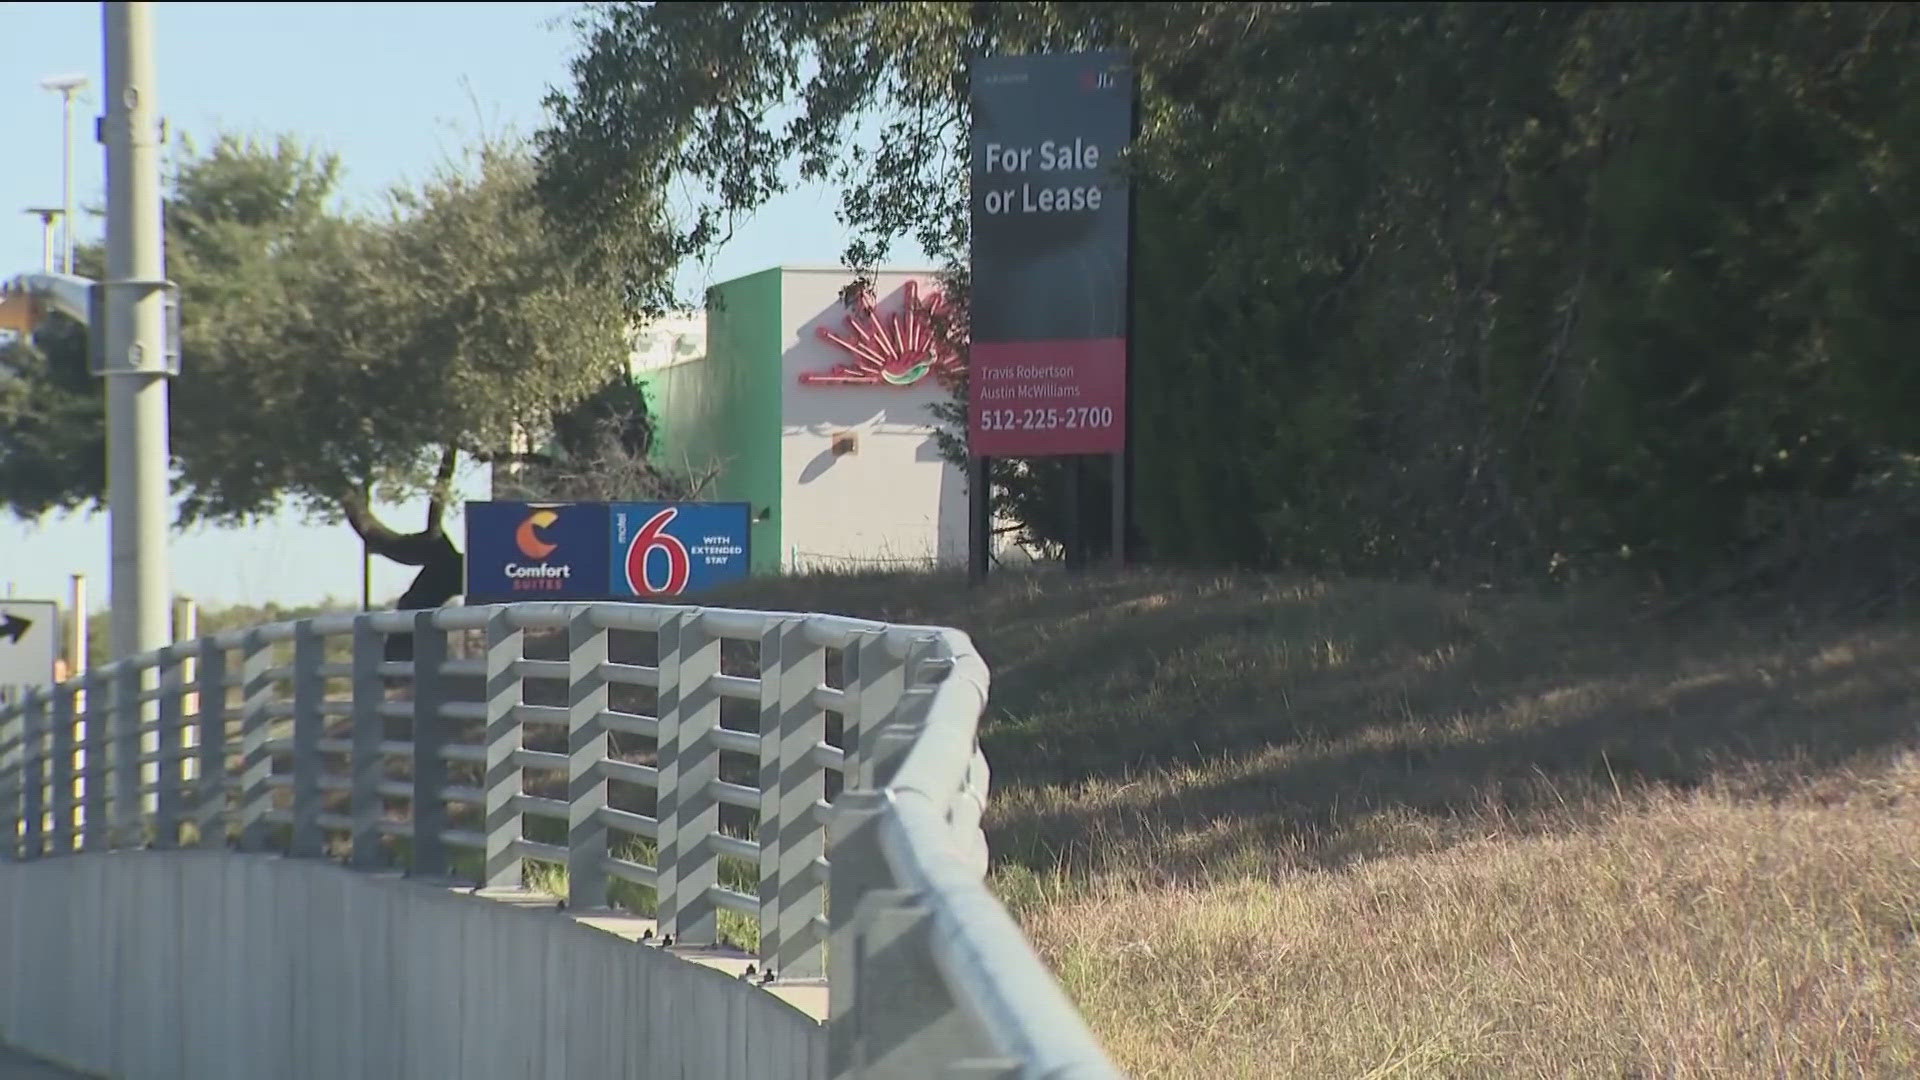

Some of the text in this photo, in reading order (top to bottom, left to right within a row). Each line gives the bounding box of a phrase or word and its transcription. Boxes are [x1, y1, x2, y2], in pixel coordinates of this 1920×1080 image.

[985, 137, 1100, 173] For Sale
[984, 182, 1102, 215] or Lease
[981, 364, 1074, 380] Travis Robertson
[980, 383, 1081, 400] Austin McWilliams
[981, 406, 1113, 431] 512-225-2700
[703, 536, 731, 545] WITH
[625, 507, 690, 596] 6
[691, 546, 742, 555] EXTENDED
[705, 556, 729, 565] STAY
[504, 562, 571, 578] Comfort
